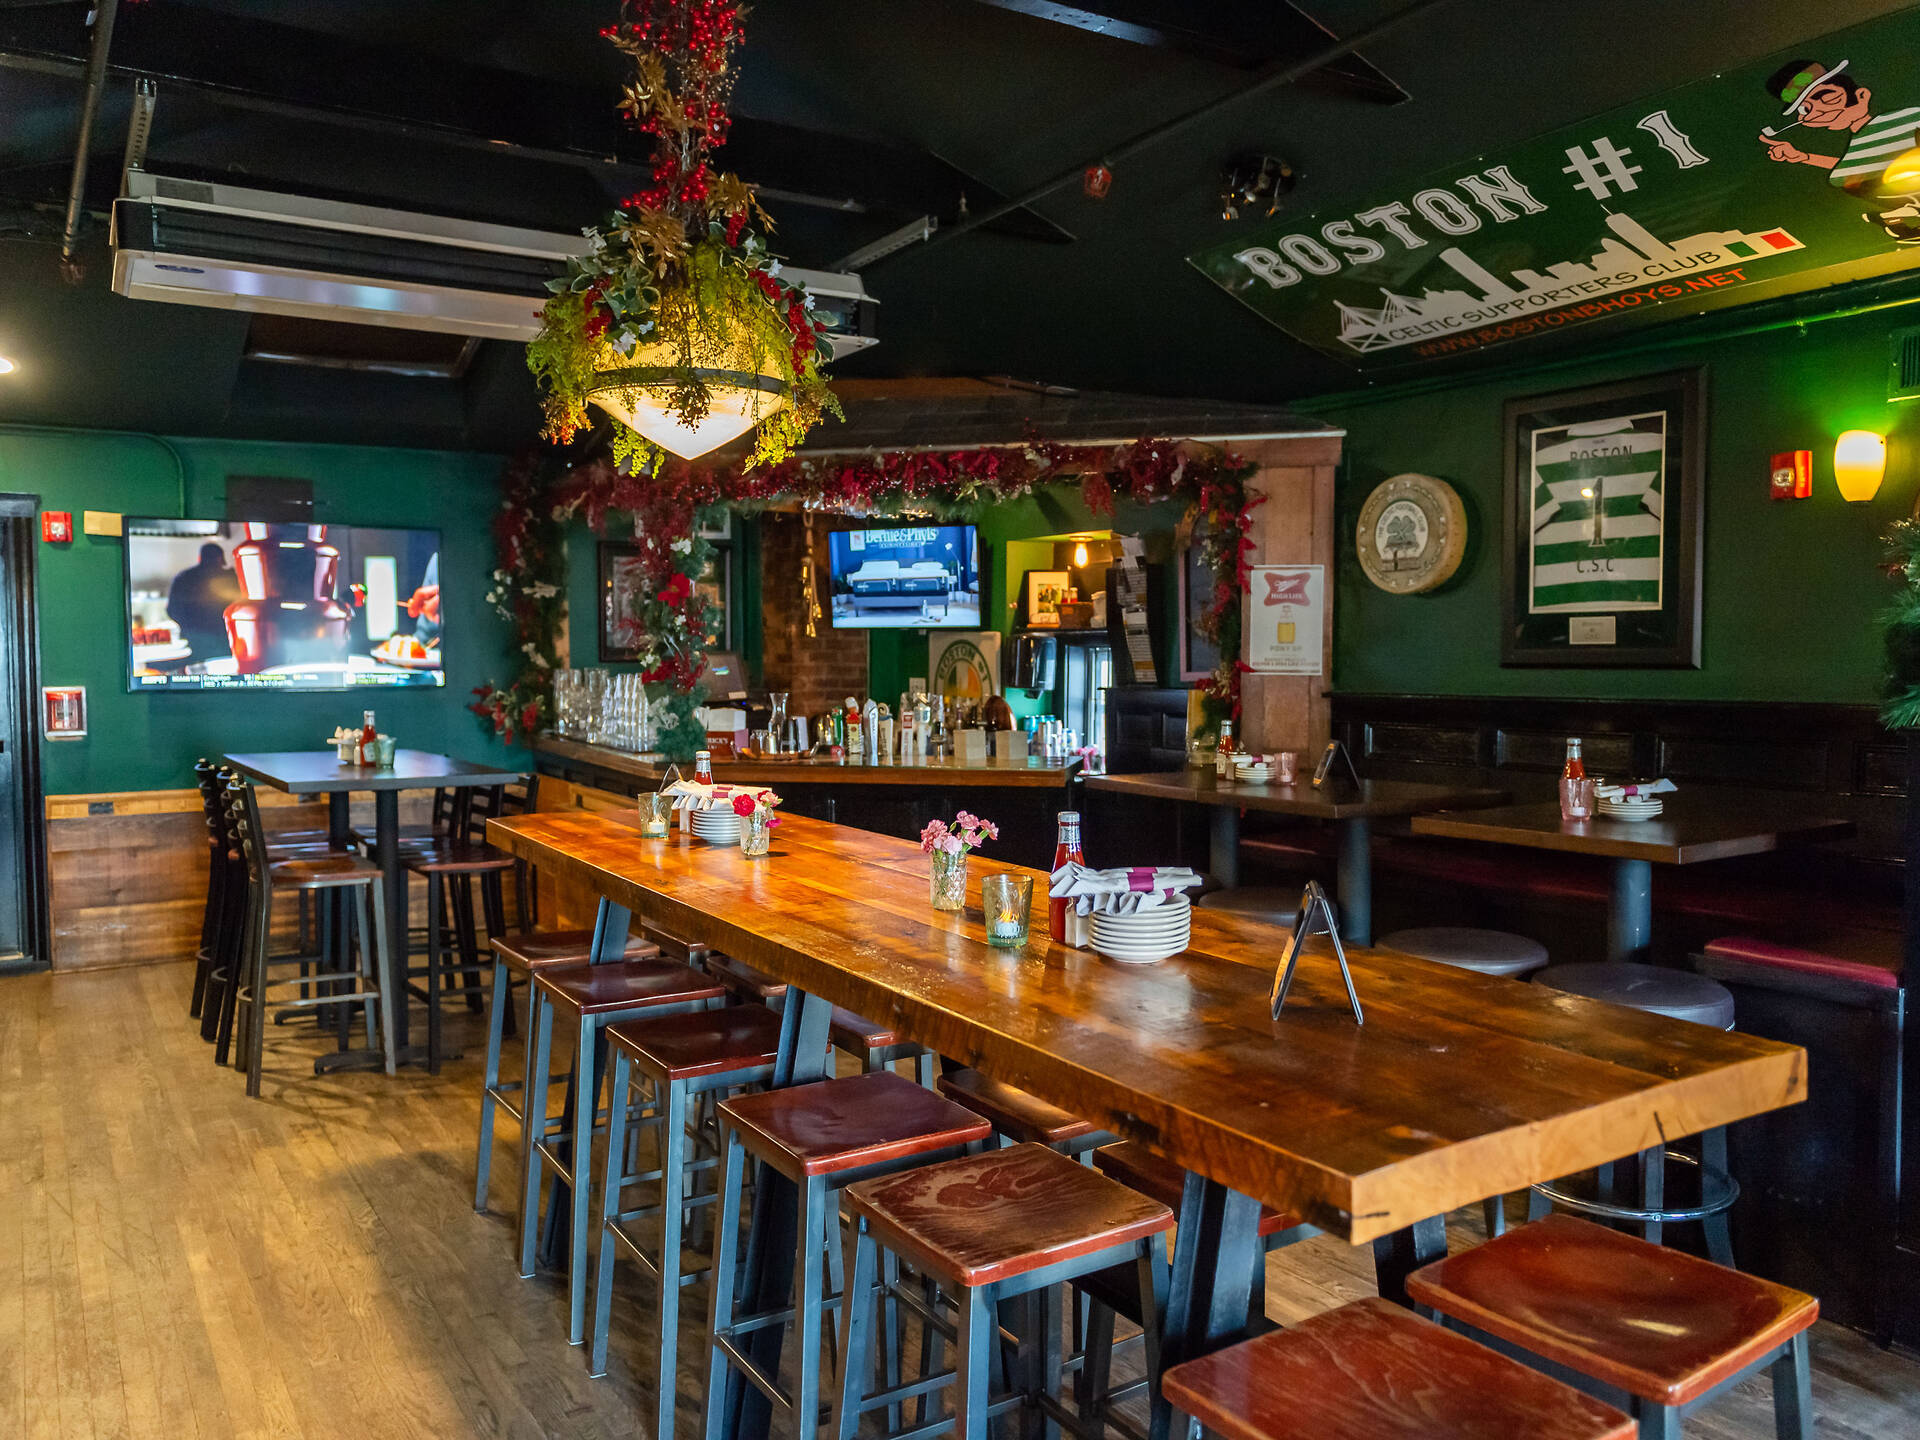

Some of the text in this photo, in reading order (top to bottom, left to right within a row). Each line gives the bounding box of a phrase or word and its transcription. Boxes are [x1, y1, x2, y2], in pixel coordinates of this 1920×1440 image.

[1233, 165, 1548, 289] BOSTON
[1389, 251, 1721, 341] CELTIC SUPPORTERS CLUB
[1418, 268, 1747, 356] WWW.BOSTONBHOYS.NET
[1570, 445, 1632, 464] BOSTON
